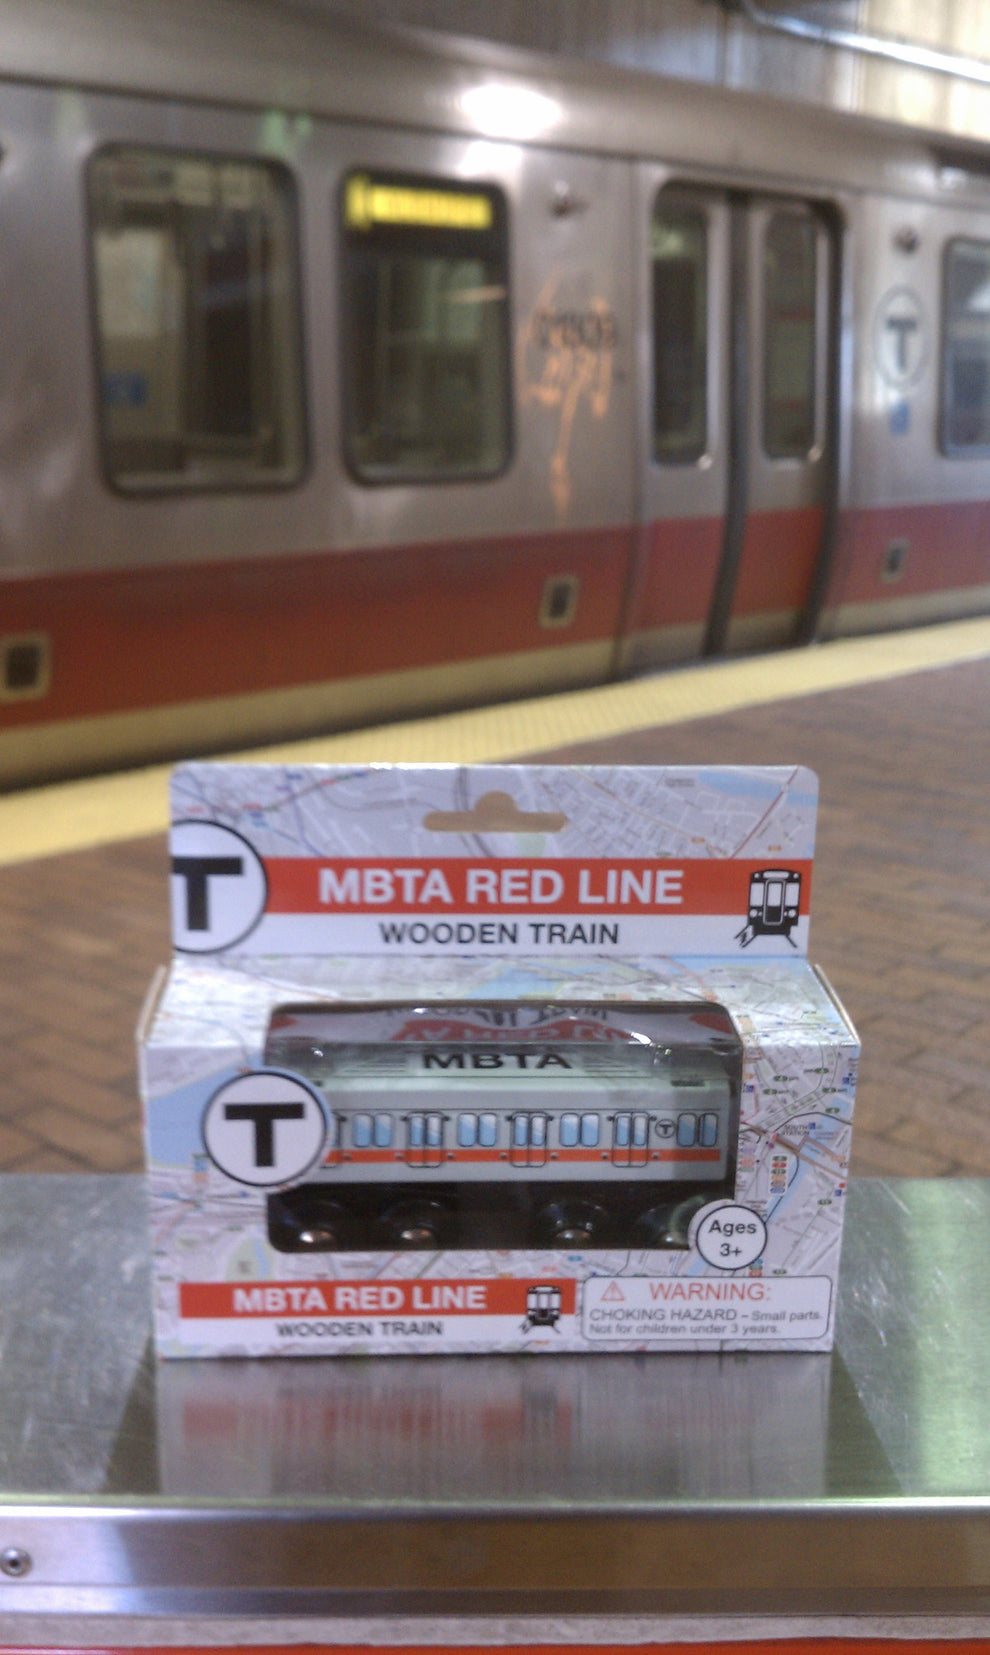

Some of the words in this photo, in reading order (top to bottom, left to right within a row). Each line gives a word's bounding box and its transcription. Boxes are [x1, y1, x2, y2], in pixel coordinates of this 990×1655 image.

[886, 317, 917, 370] T
[171, 856, 243, 931] T
[319, 868, 453, 905] MBTA
[466, 868, 564, 905] RED
[578, 869, 684, 905] LINE
[379, 922, 518, 945] WOODEN
[532, 922, 619, 945] TRAIN
[422, 1052, 572, 1070] MBTA
[224, 1102, 305, 1168] T
[708, 1218, 757, 1238] Ages
[719, 1242, 742, 1258] 3+
[233, 1287, 327, 1312] MBTA
[335, 1286, 404, 1311] RED
[412, 1285, 487, 1310] LINE
[649, 1282, 771, 1301] WARNING:
[589, 1308, 666, 1321] CHOKING
[670, 1308, 738, 1321] HAZARD
[751, 1309, 786, 1321] Small
[276, 1321, 373, 1337] WOODEN
[379, 1320, 443, 1336] TRAIN
[589, 1324, 612, 1334] Not
[615, 1323, 632, 1334] for
[636, 1323, 686, 1334] children
[690, 1324, 726, 1334] under
[730, 1324, 738, 1334] 3
